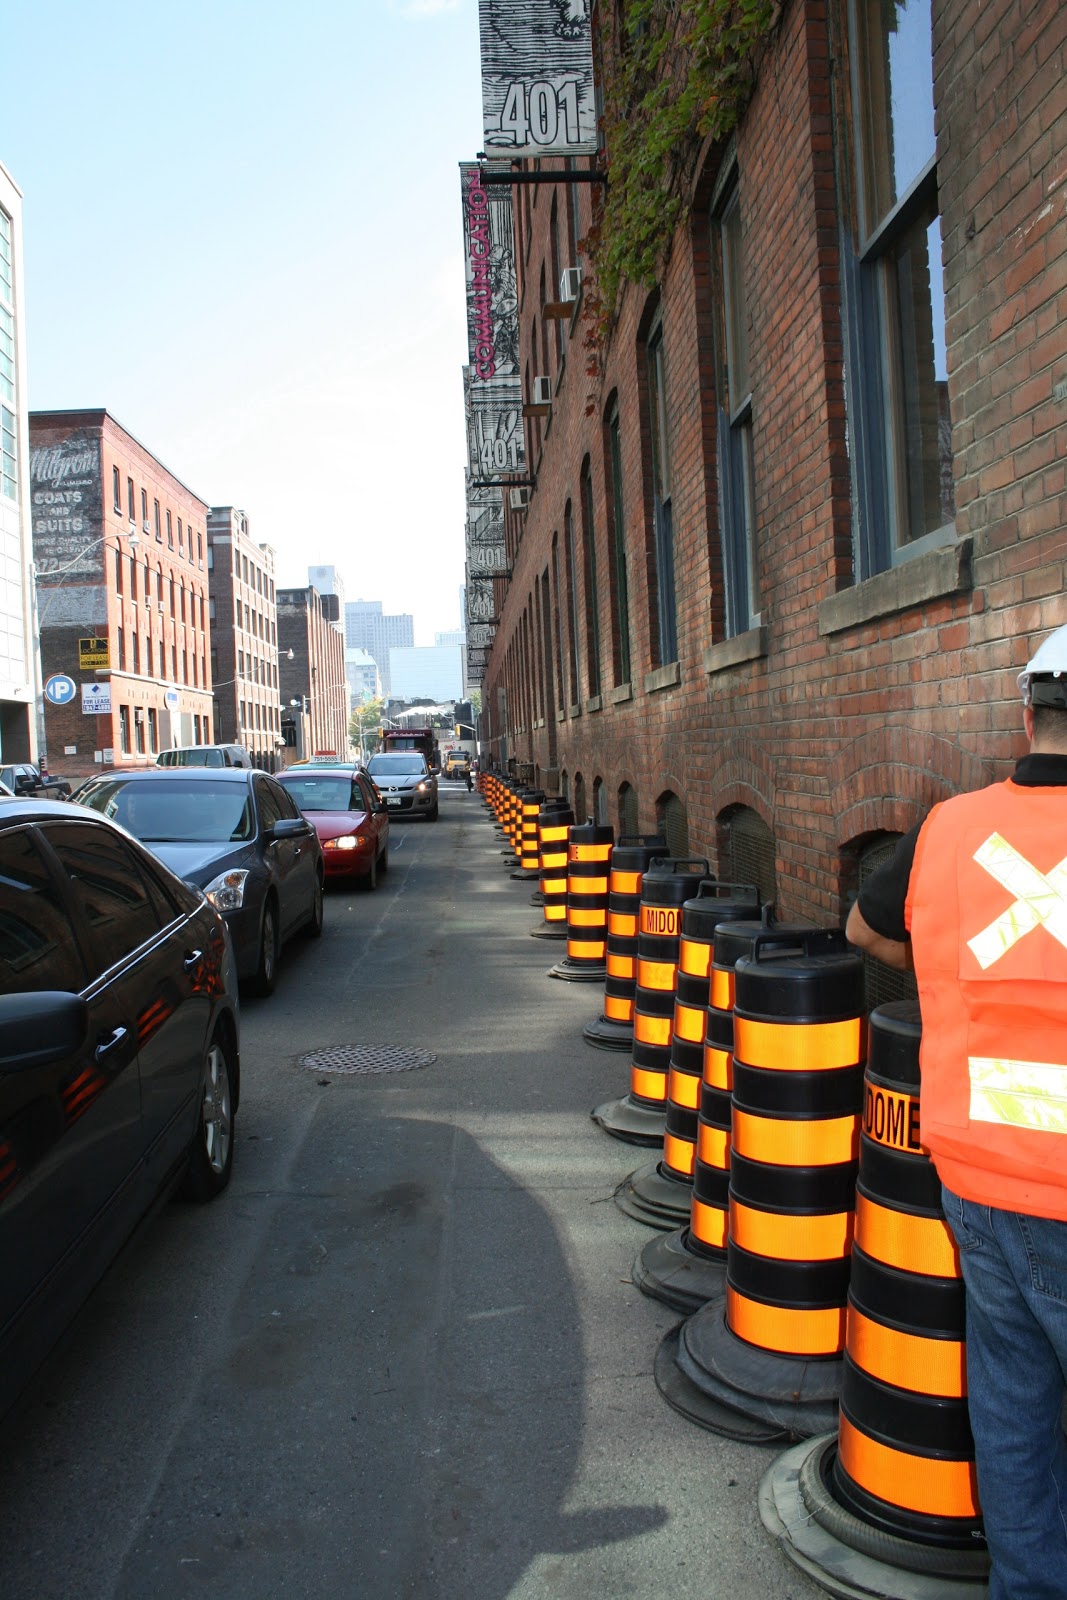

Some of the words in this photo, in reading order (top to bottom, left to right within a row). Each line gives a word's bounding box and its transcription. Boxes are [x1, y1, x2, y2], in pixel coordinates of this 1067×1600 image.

[500, 80, 580, 146] 401
[467, 170, 495, 380] COMMUNICATION
[480, 438, 519, 470] 401
[34, 491, 82, 504] COATS
[36, 518, 83, 533] SUITS
[477, 548, 501, 568] 401
[473, 601, 491, 616] 401
